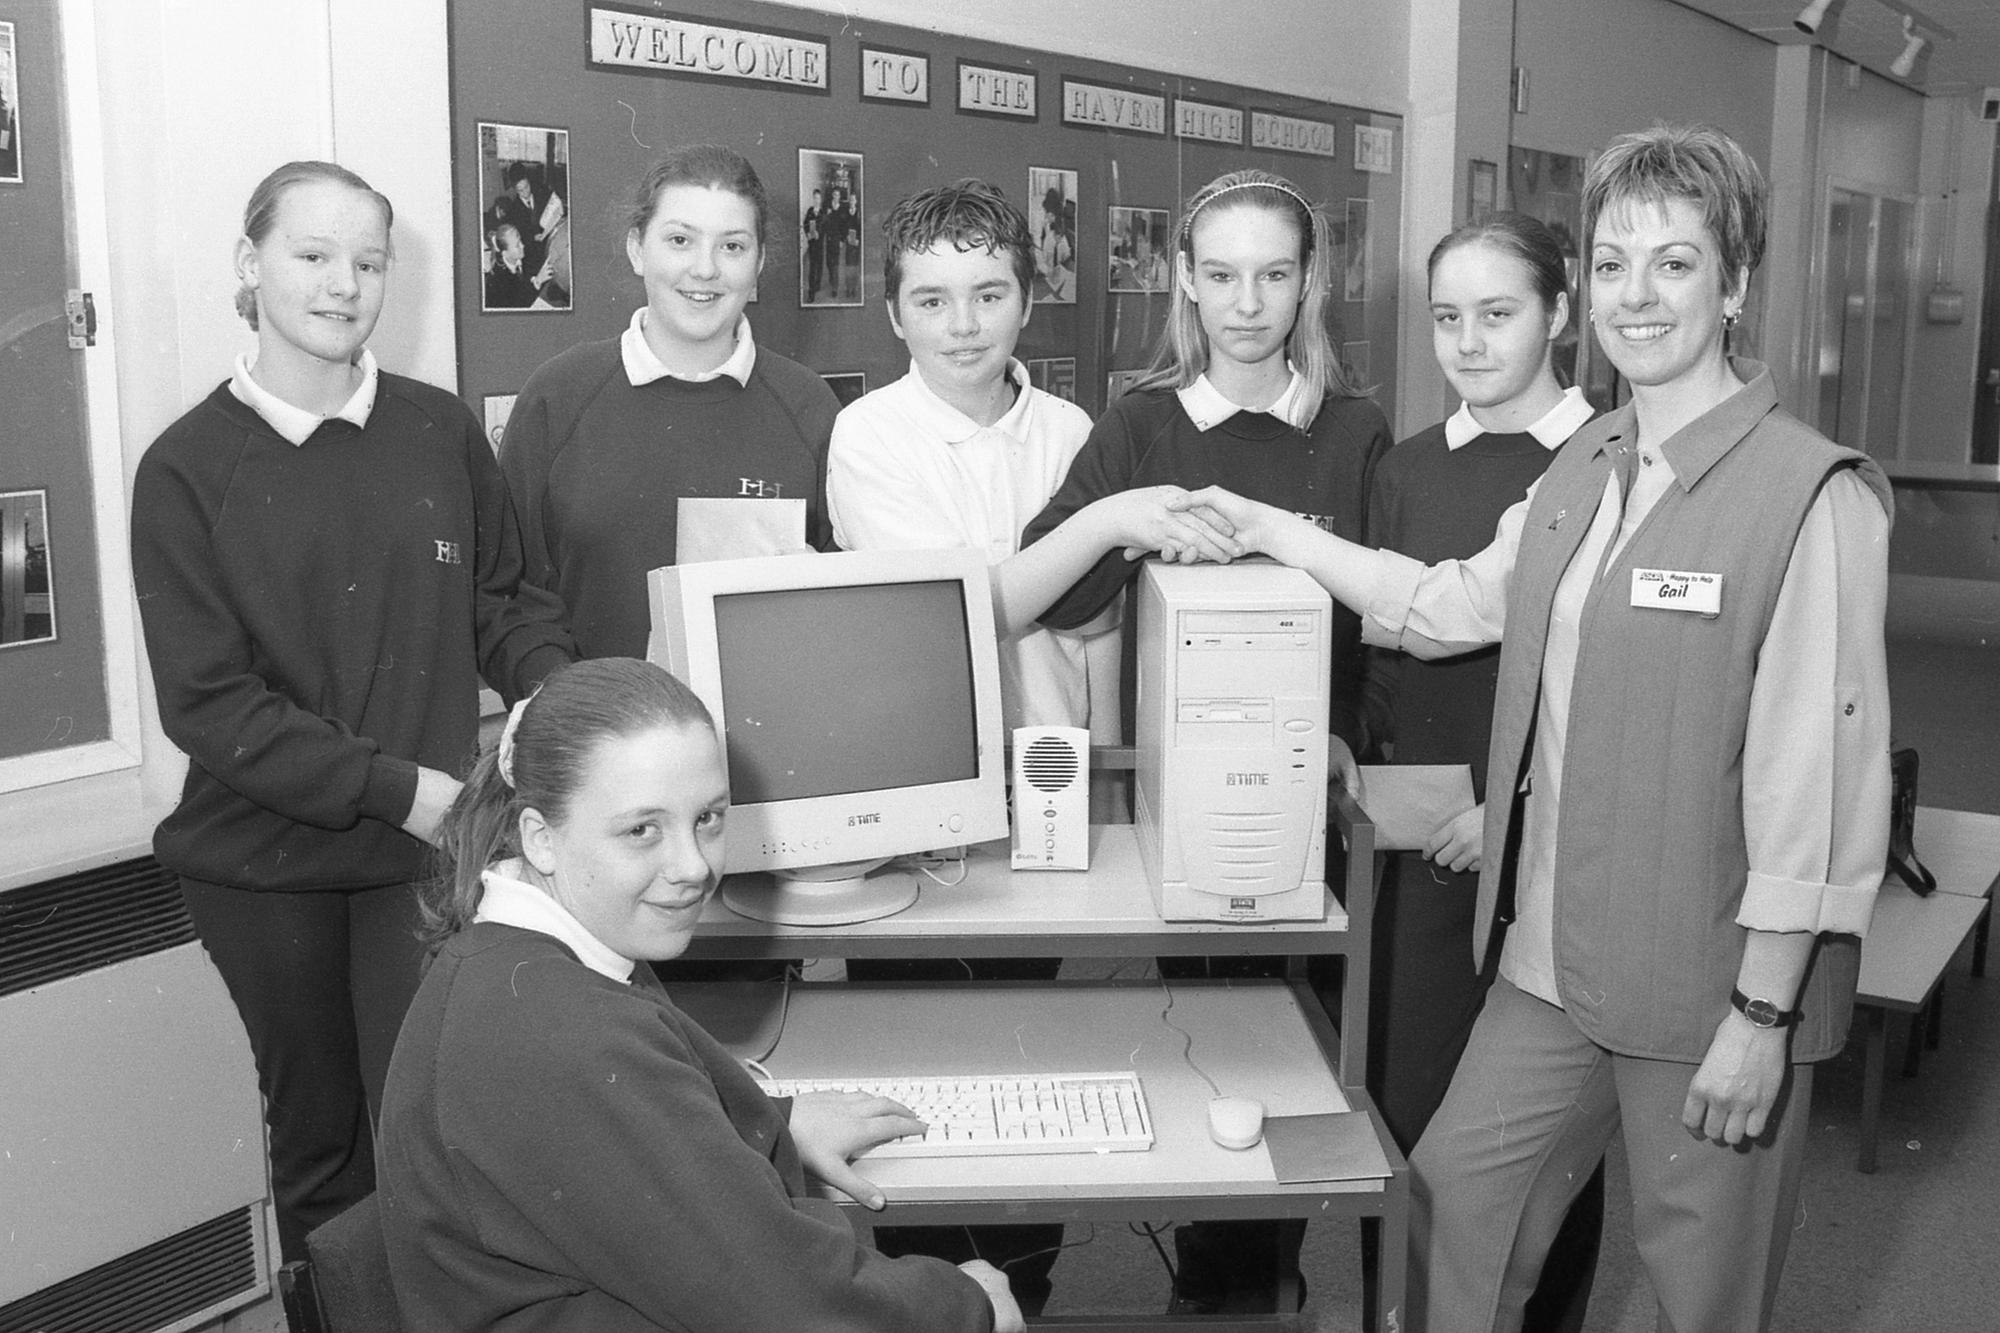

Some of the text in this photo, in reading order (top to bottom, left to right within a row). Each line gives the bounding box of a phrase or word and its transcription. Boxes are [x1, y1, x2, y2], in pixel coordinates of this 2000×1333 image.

[609, 21, 1332, 152] WELCOME TO THE HAVEN HIGH SCHOOL
[1669, 574, 1690, 583] Happy
[1700, 576, 1714, 584] Help
[1658, 583, 1689, 598] Gail
[1236, 772, 1270, 786] TIME
[856, 812, 881, 825] TIME
